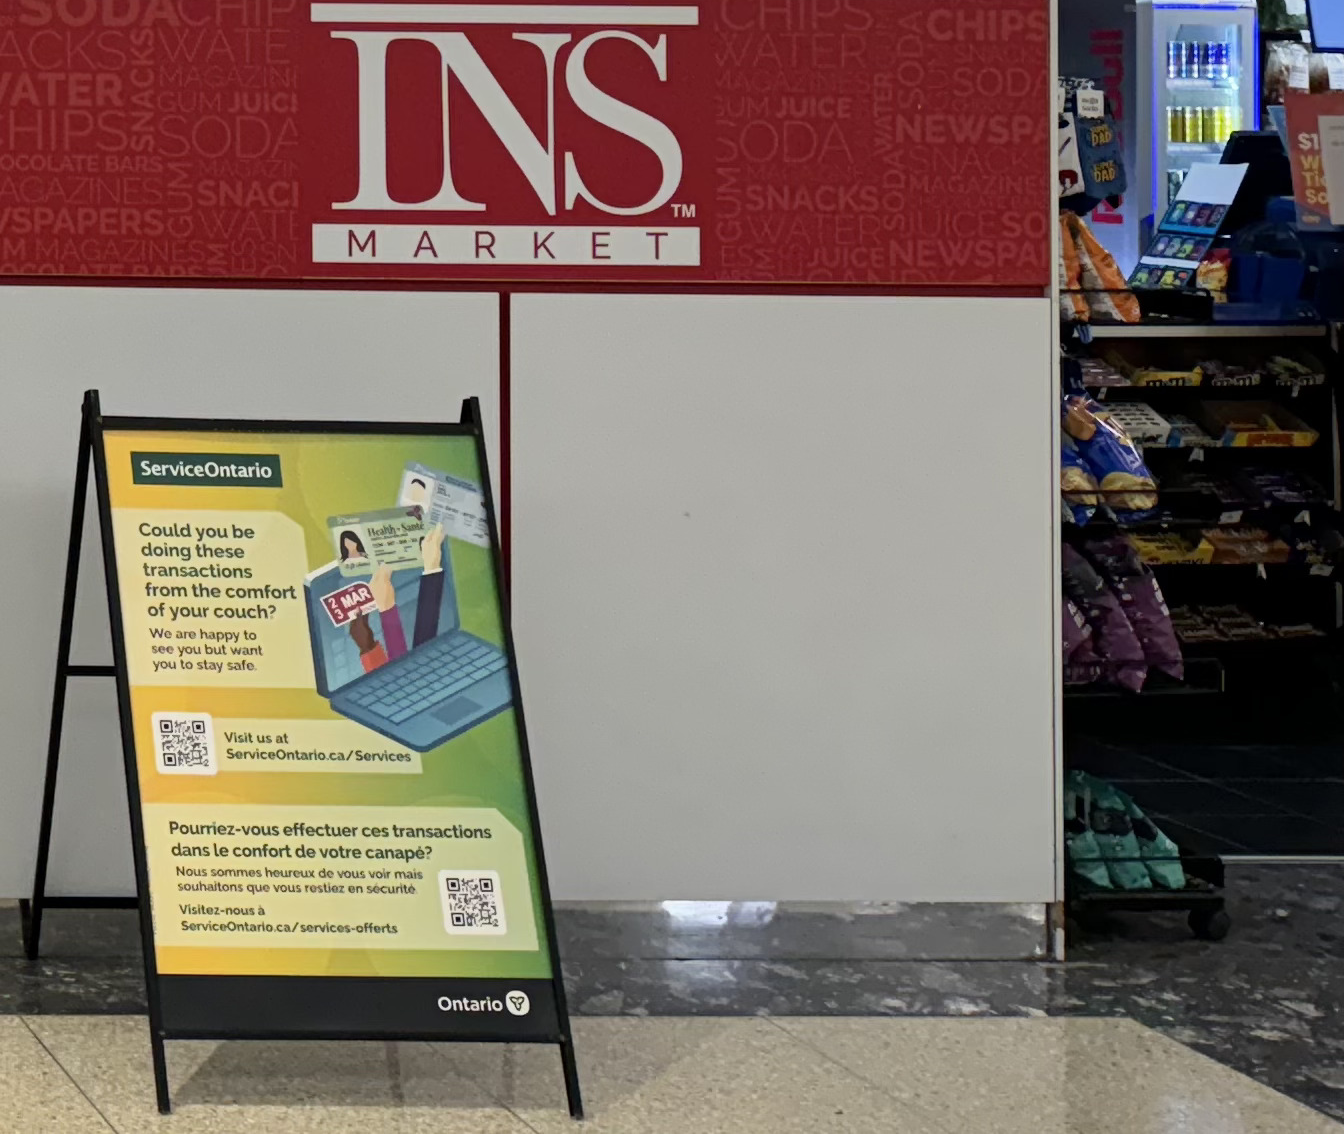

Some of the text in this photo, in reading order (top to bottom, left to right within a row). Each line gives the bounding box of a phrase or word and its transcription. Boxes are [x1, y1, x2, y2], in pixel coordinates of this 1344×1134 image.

[330, 30, 682, 215] INS
[671, 204, 695, 217] TM
[347, 230, 668, 259] MARKET
[140, 460, 272, 479] ServiceOntario
[138, 523, 255, 543] Could you be
[141, 542, 245, 562] doing these
[143, 563, 252, 579] transactions
[145, 583, 297, 600] from the comfort
[340, 588, 371, 609] MAR
[148, 603, 277, 622] of your couch?
[149, 628, 256, 644] We are happy to
[152, 643, 263, 659] see you but want
[152, 659, 257, 674] you to stay safe.
[224, 732, 288, 744] Visit us at
[226, 748, 411, 763] ServiceOntario.ca/Services
[169, 821, 491, 839] Pourriez-vous effectuer ces transactions
[171, 843, 211, 857] dans
[215, 842, 228, 857] le
[232, 843, 291, 858] confort
[295, 844, 315, 858] de
[319, 845, 361, 859] votre
[179, 905, 254, 916] Visitez-nous
[437, 995, 503, 1012] Ontario
